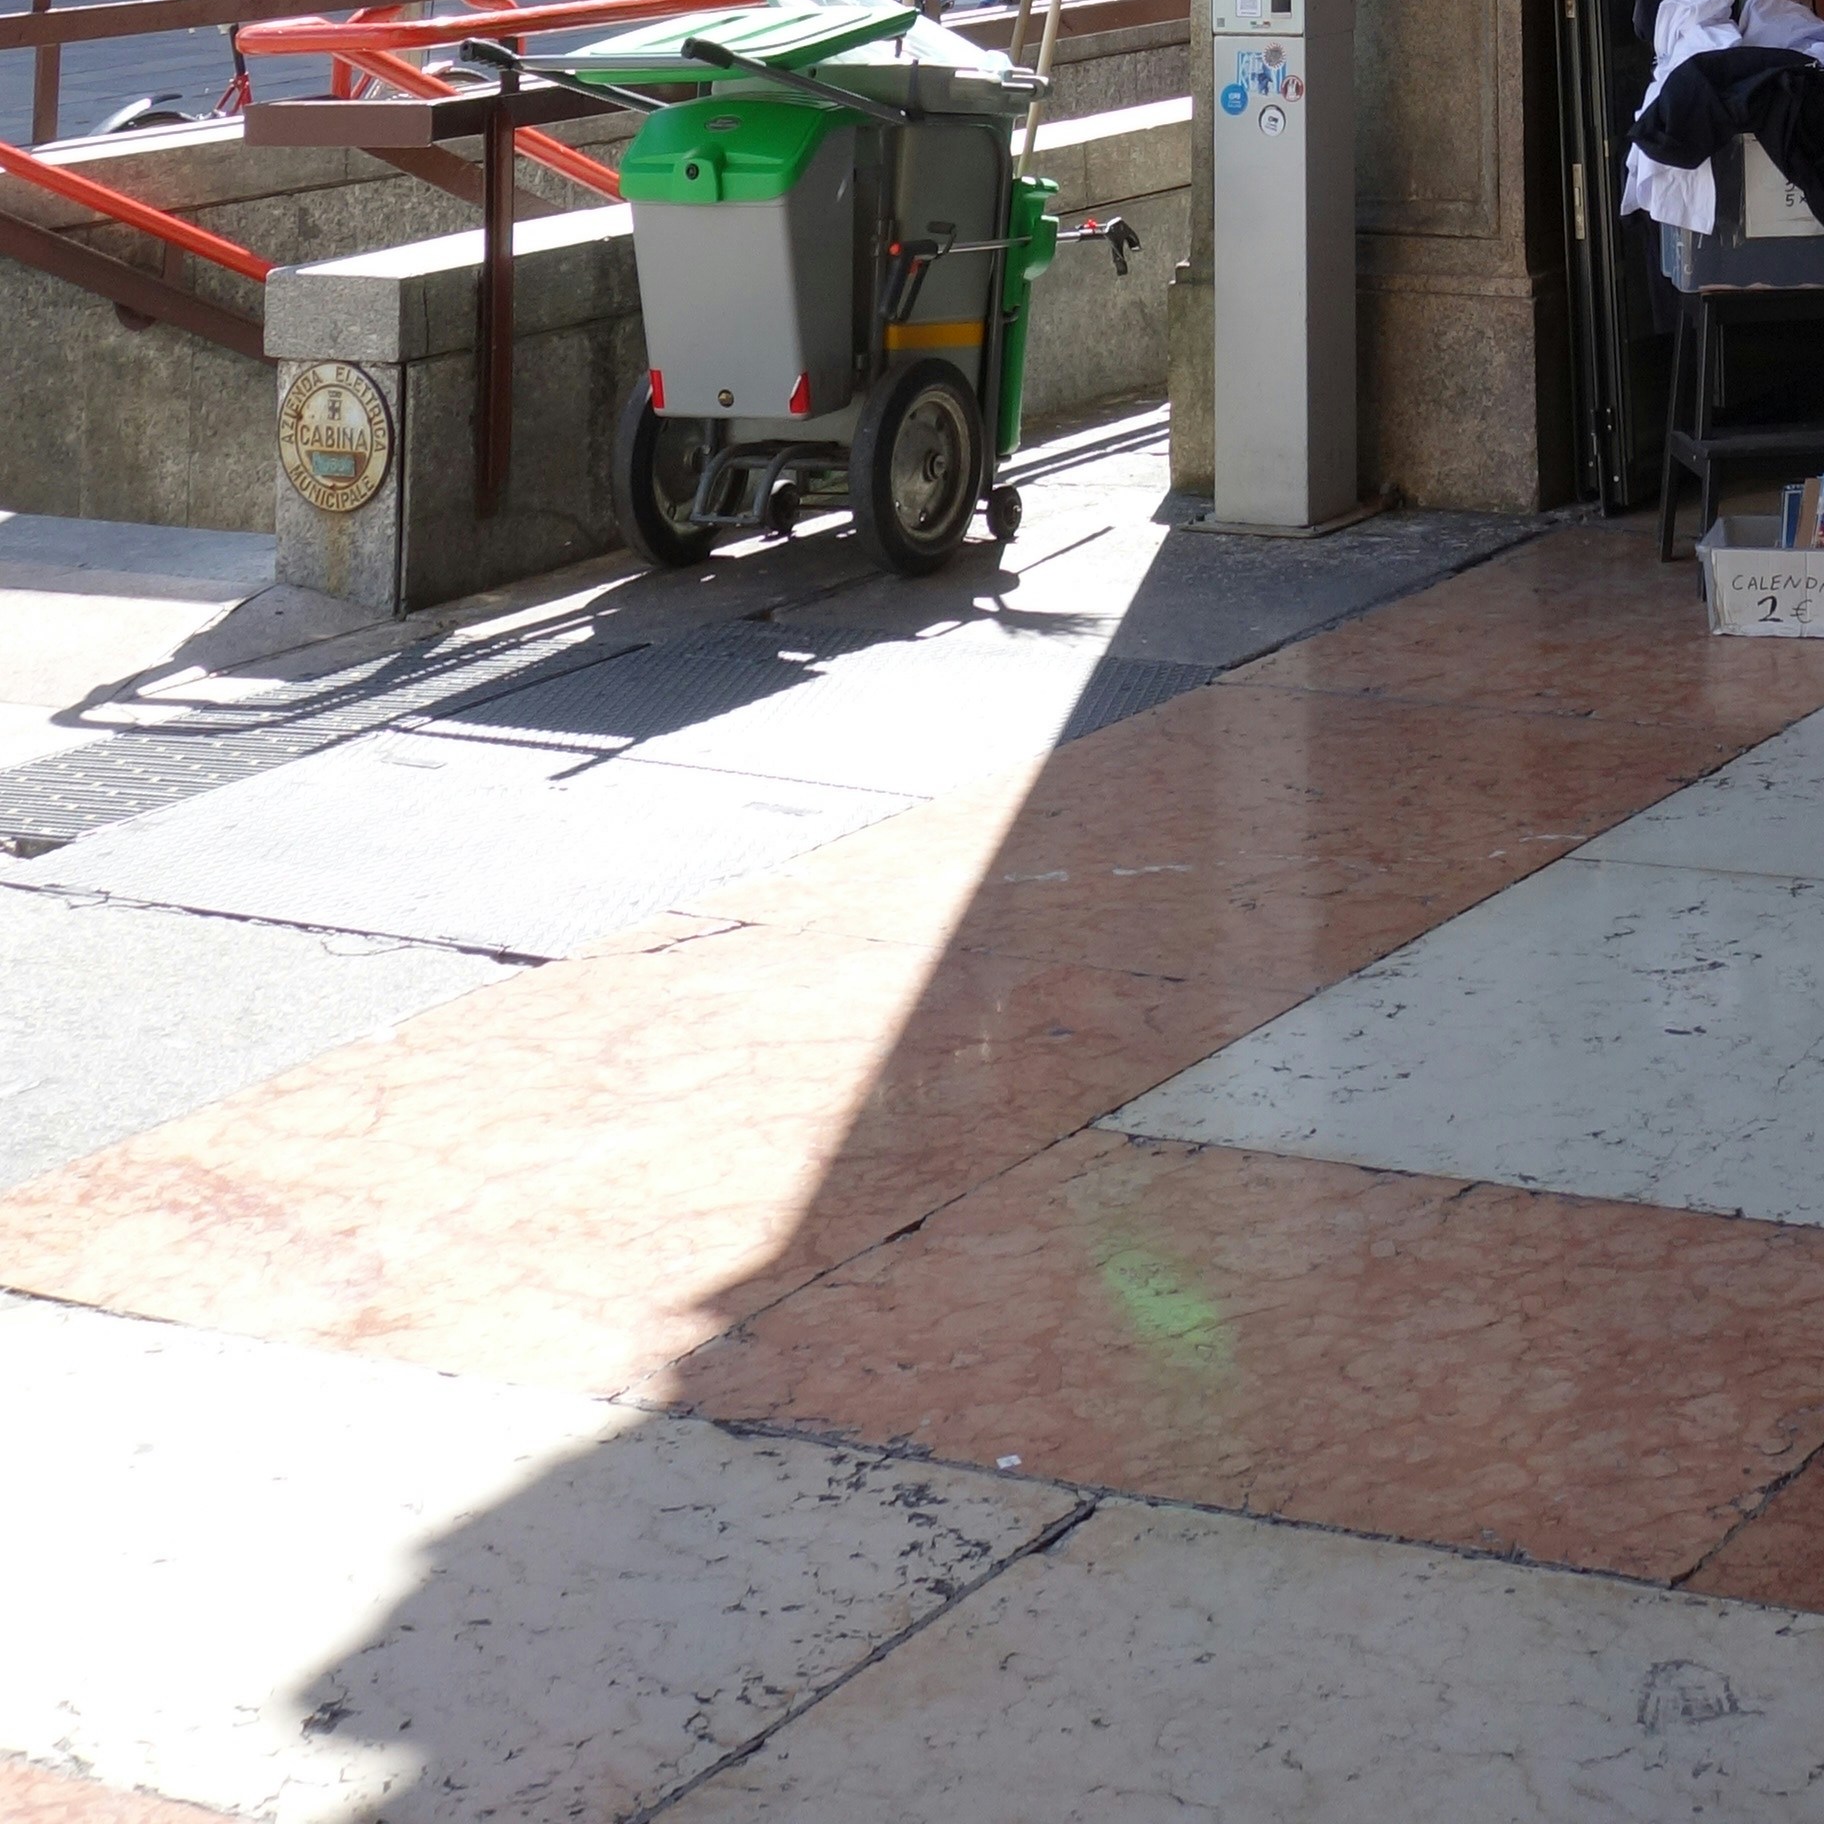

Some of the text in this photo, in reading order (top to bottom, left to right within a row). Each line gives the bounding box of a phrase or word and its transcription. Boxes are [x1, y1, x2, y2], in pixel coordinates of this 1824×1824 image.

[281, 366, 386, 452] AZIENDA ELETTRICA
[300, 424, 368, 451] CABINA
[289, 463, 376, 509] MUNICIPALE
[1757, 595, 1783, 623] 2
[1790, 599, 1813, 624] €
